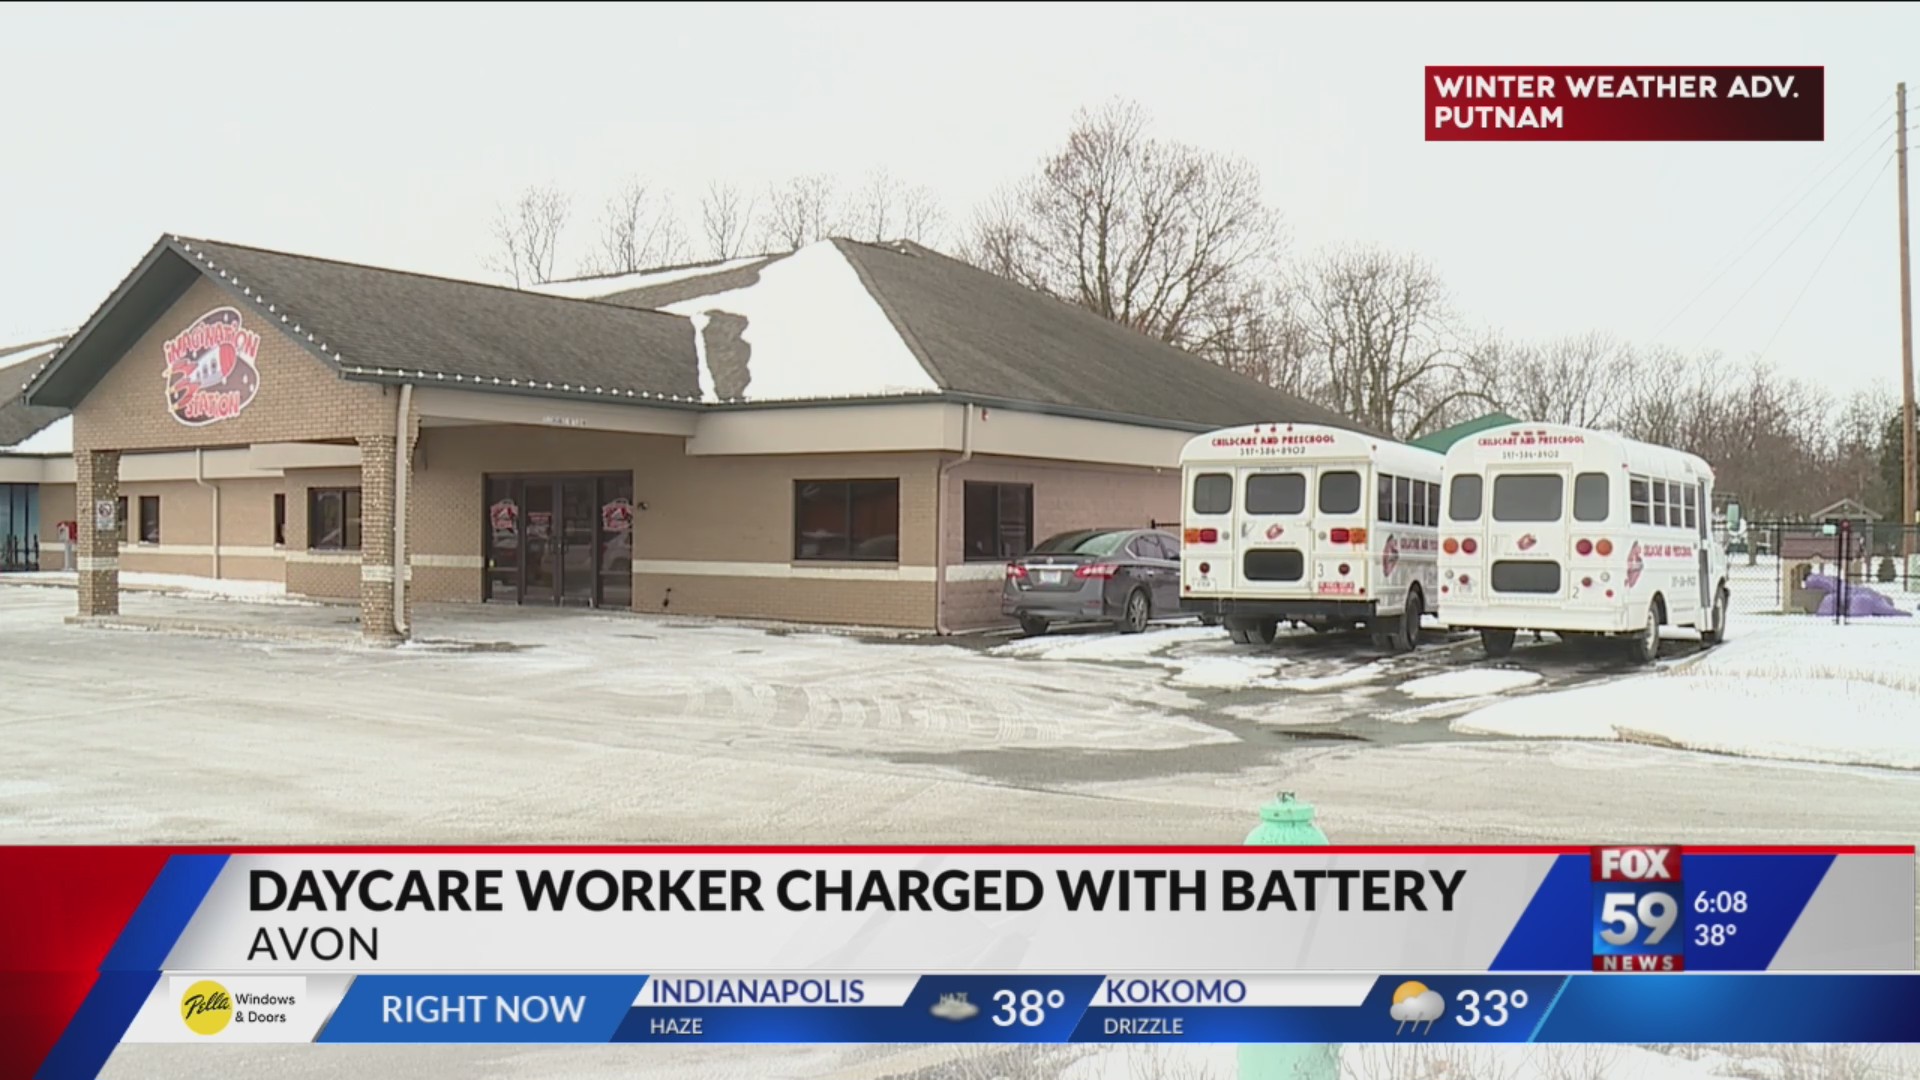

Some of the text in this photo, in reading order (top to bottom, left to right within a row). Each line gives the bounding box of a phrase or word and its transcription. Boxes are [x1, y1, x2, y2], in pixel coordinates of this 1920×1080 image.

[185, 391, 240, 418] STATION
[1211, 434, 1335, 447] CHILDCARE AND PRESCHOOL
[1477, 435, 1585, 447] CHILDCARE AND PRESCHOOL
[1317, 563, 1325, 578] 3
[1572, 586, 1579, 599] 2
